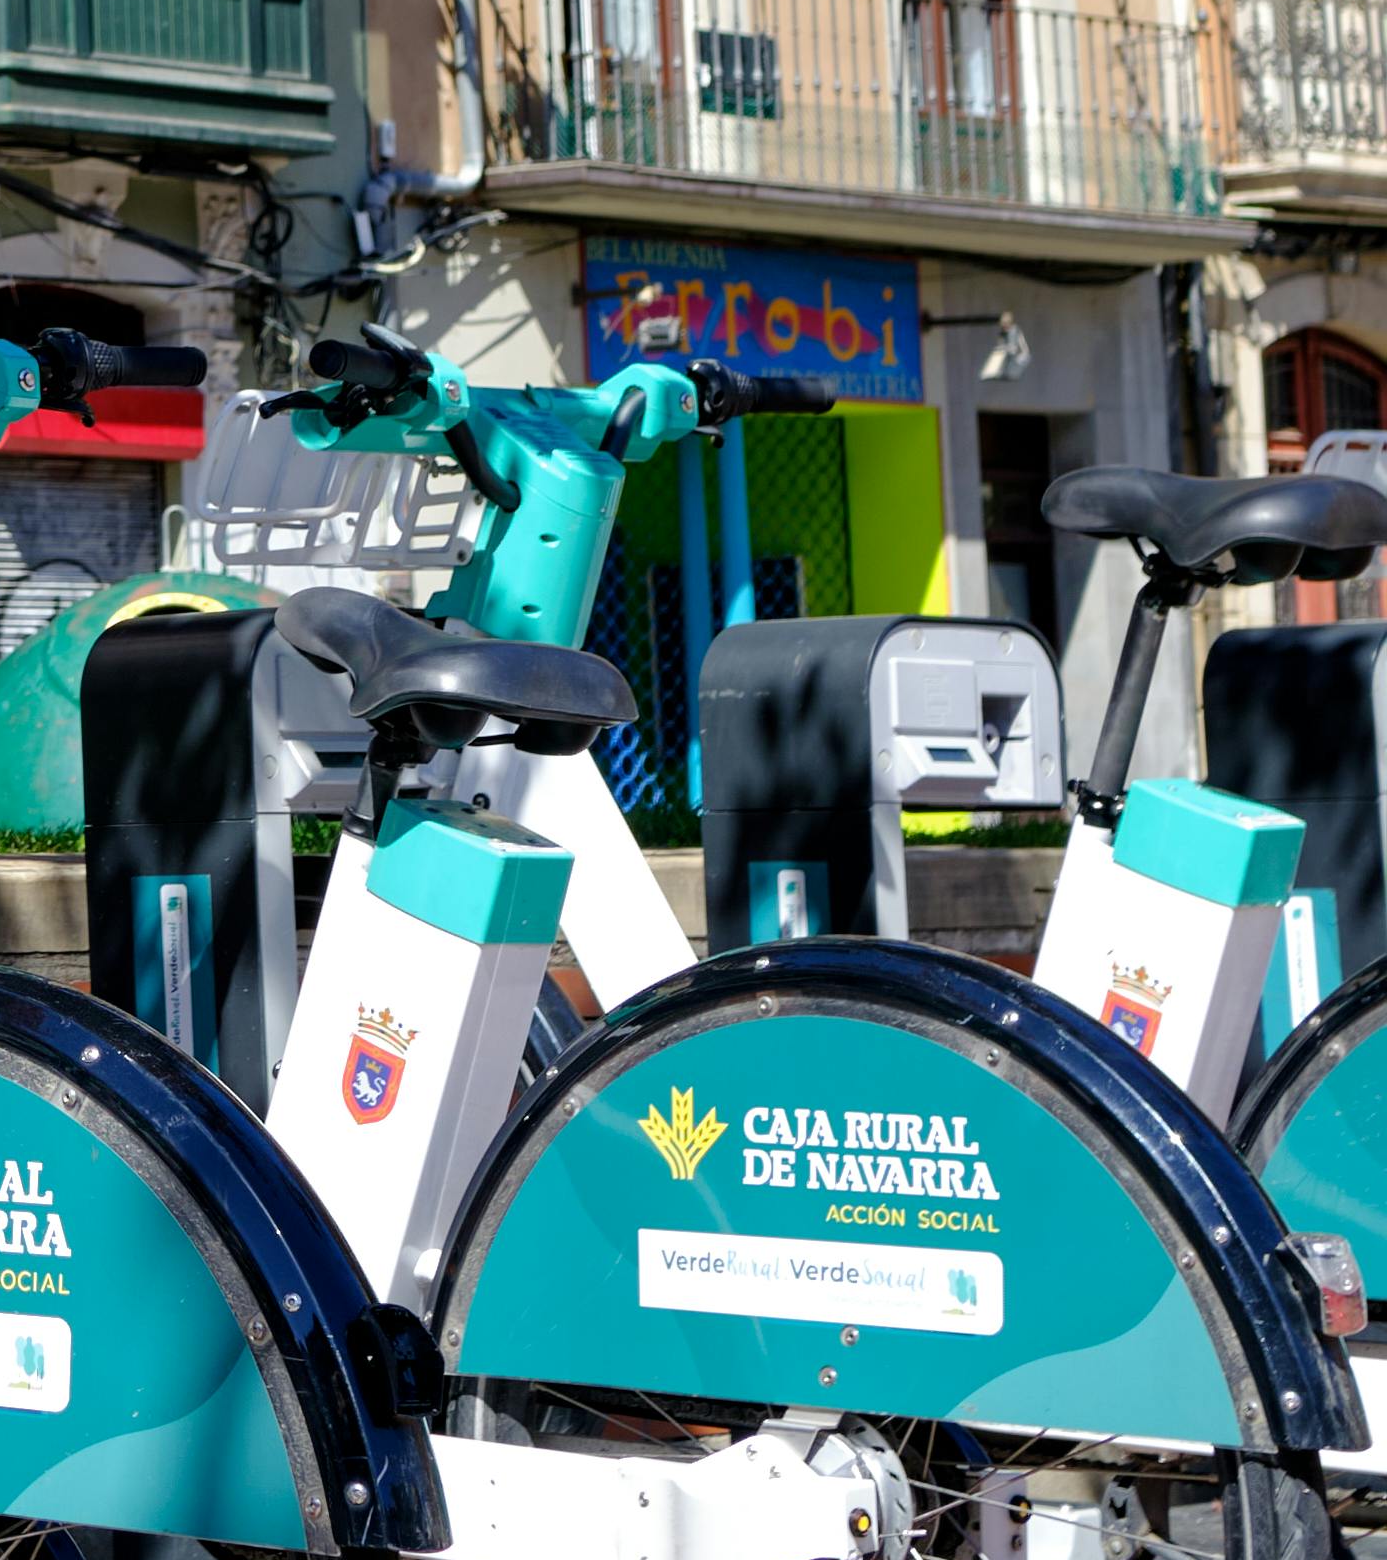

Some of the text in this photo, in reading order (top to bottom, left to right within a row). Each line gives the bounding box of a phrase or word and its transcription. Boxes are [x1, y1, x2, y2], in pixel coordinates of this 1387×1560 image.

[744, 1107, 979, 1156] CAJA RURAL
[742, 1148, 1000, 1200] DE NAVARRA
[826, 1202, 1000, 1233] ACCIÓN SOCIAL
